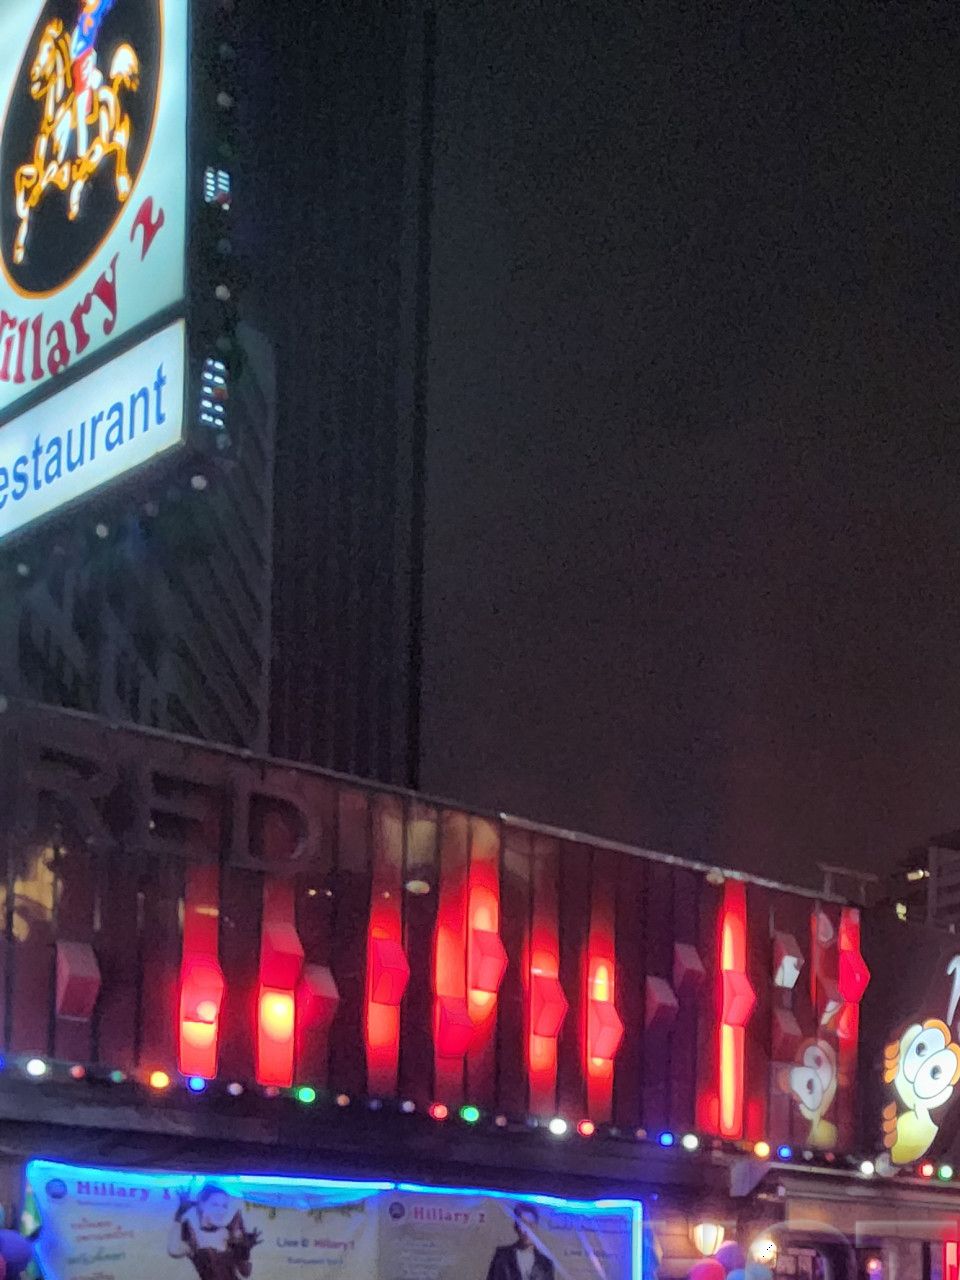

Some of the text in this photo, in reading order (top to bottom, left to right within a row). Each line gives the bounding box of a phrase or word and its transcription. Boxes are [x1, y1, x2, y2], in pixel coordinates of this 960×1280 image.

[130, 196, 165, 260] 2
[77, 1181, 149, 1200] Hillary
[414, 1206, 471, 1222] Hillary
